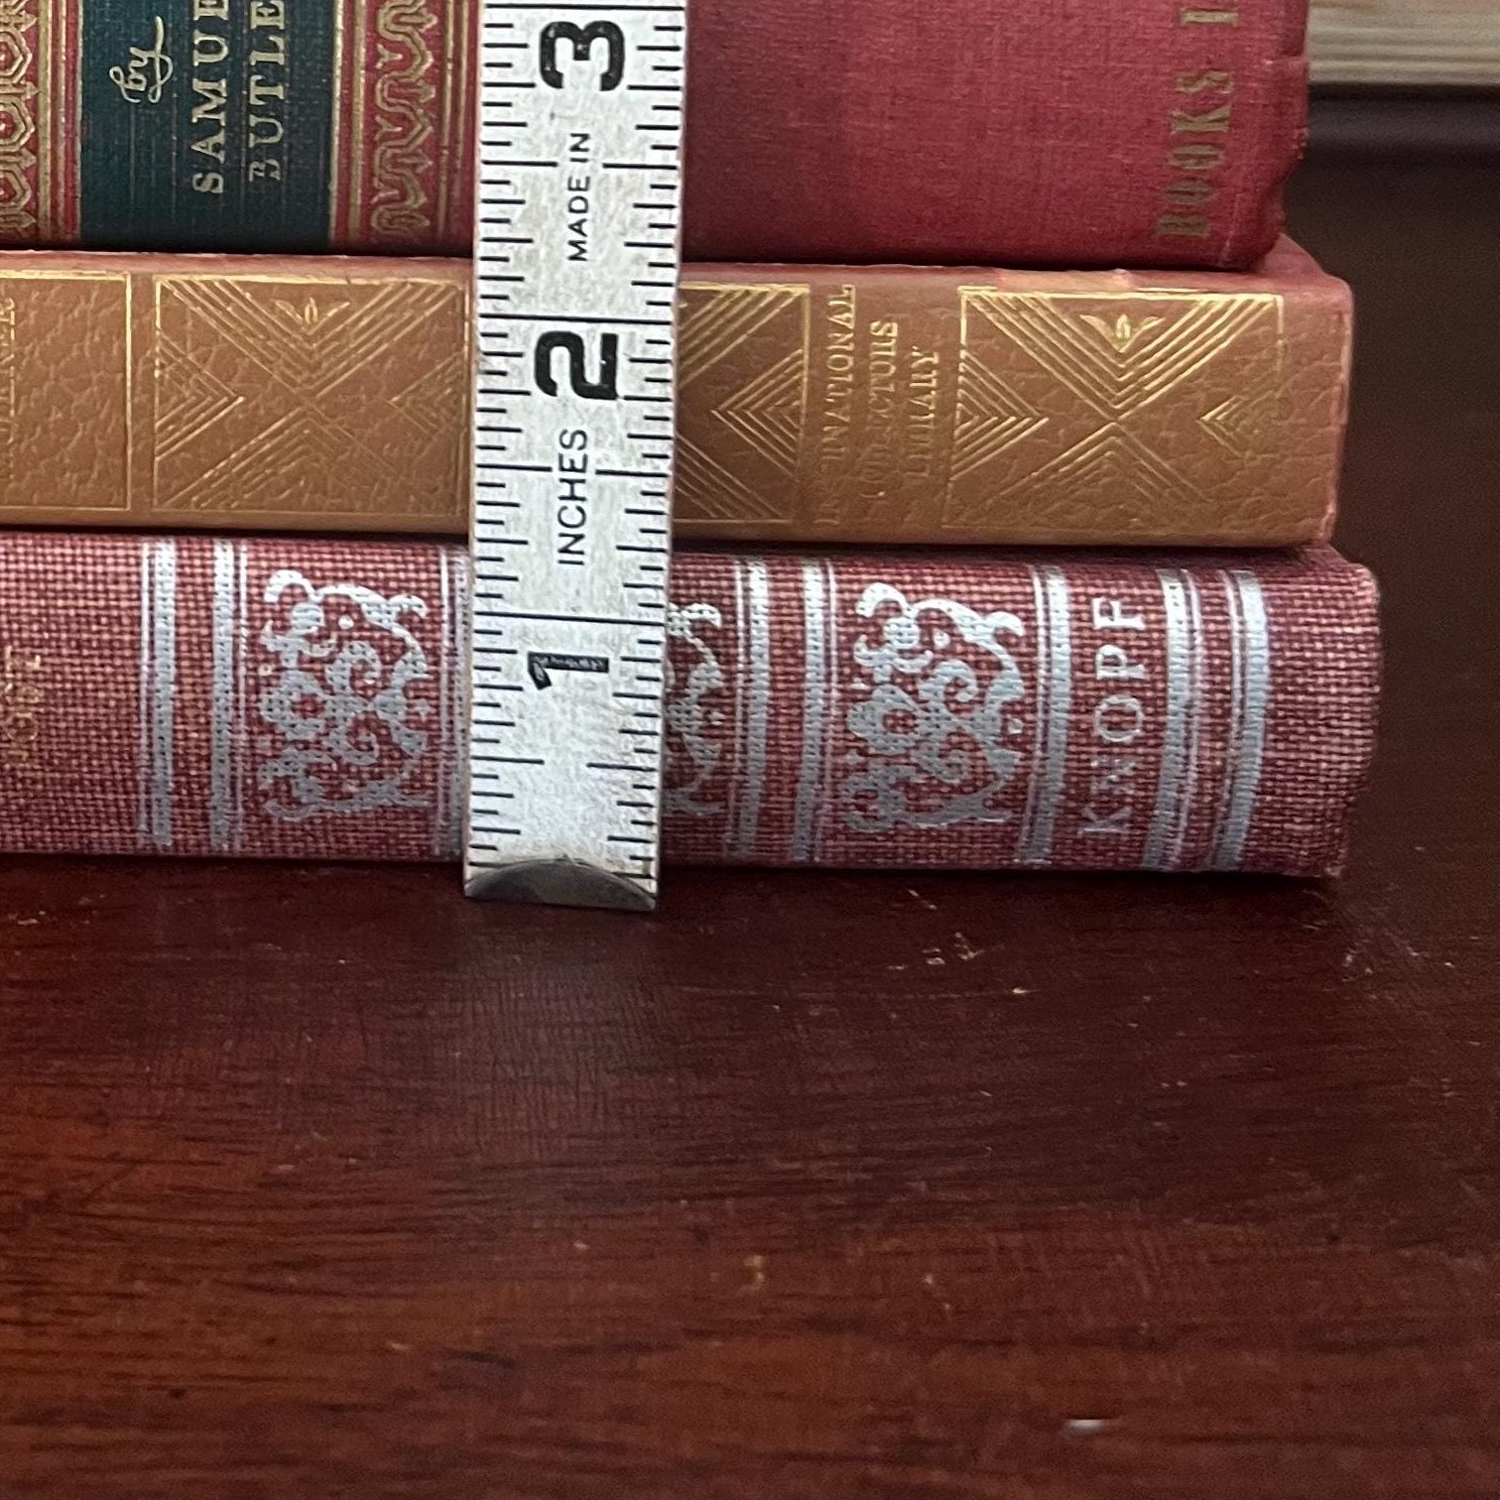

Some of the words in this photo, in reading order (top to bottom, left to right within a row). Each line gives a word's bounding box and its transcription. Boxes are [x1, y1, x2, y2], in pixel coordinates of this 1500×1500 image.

[539, 20, 625, 92] 3
[570, 132, 590, 163] IN
[1154, 71, 1236, 238] BOOKS
[568, 175, 590, 261] MADE
[534, 330, 619, 400] 2
[558, 429, 588, 566] INCHES
[527, 651, 610, 690] 1
[1077, 598, 1147, 838] KNOPF
